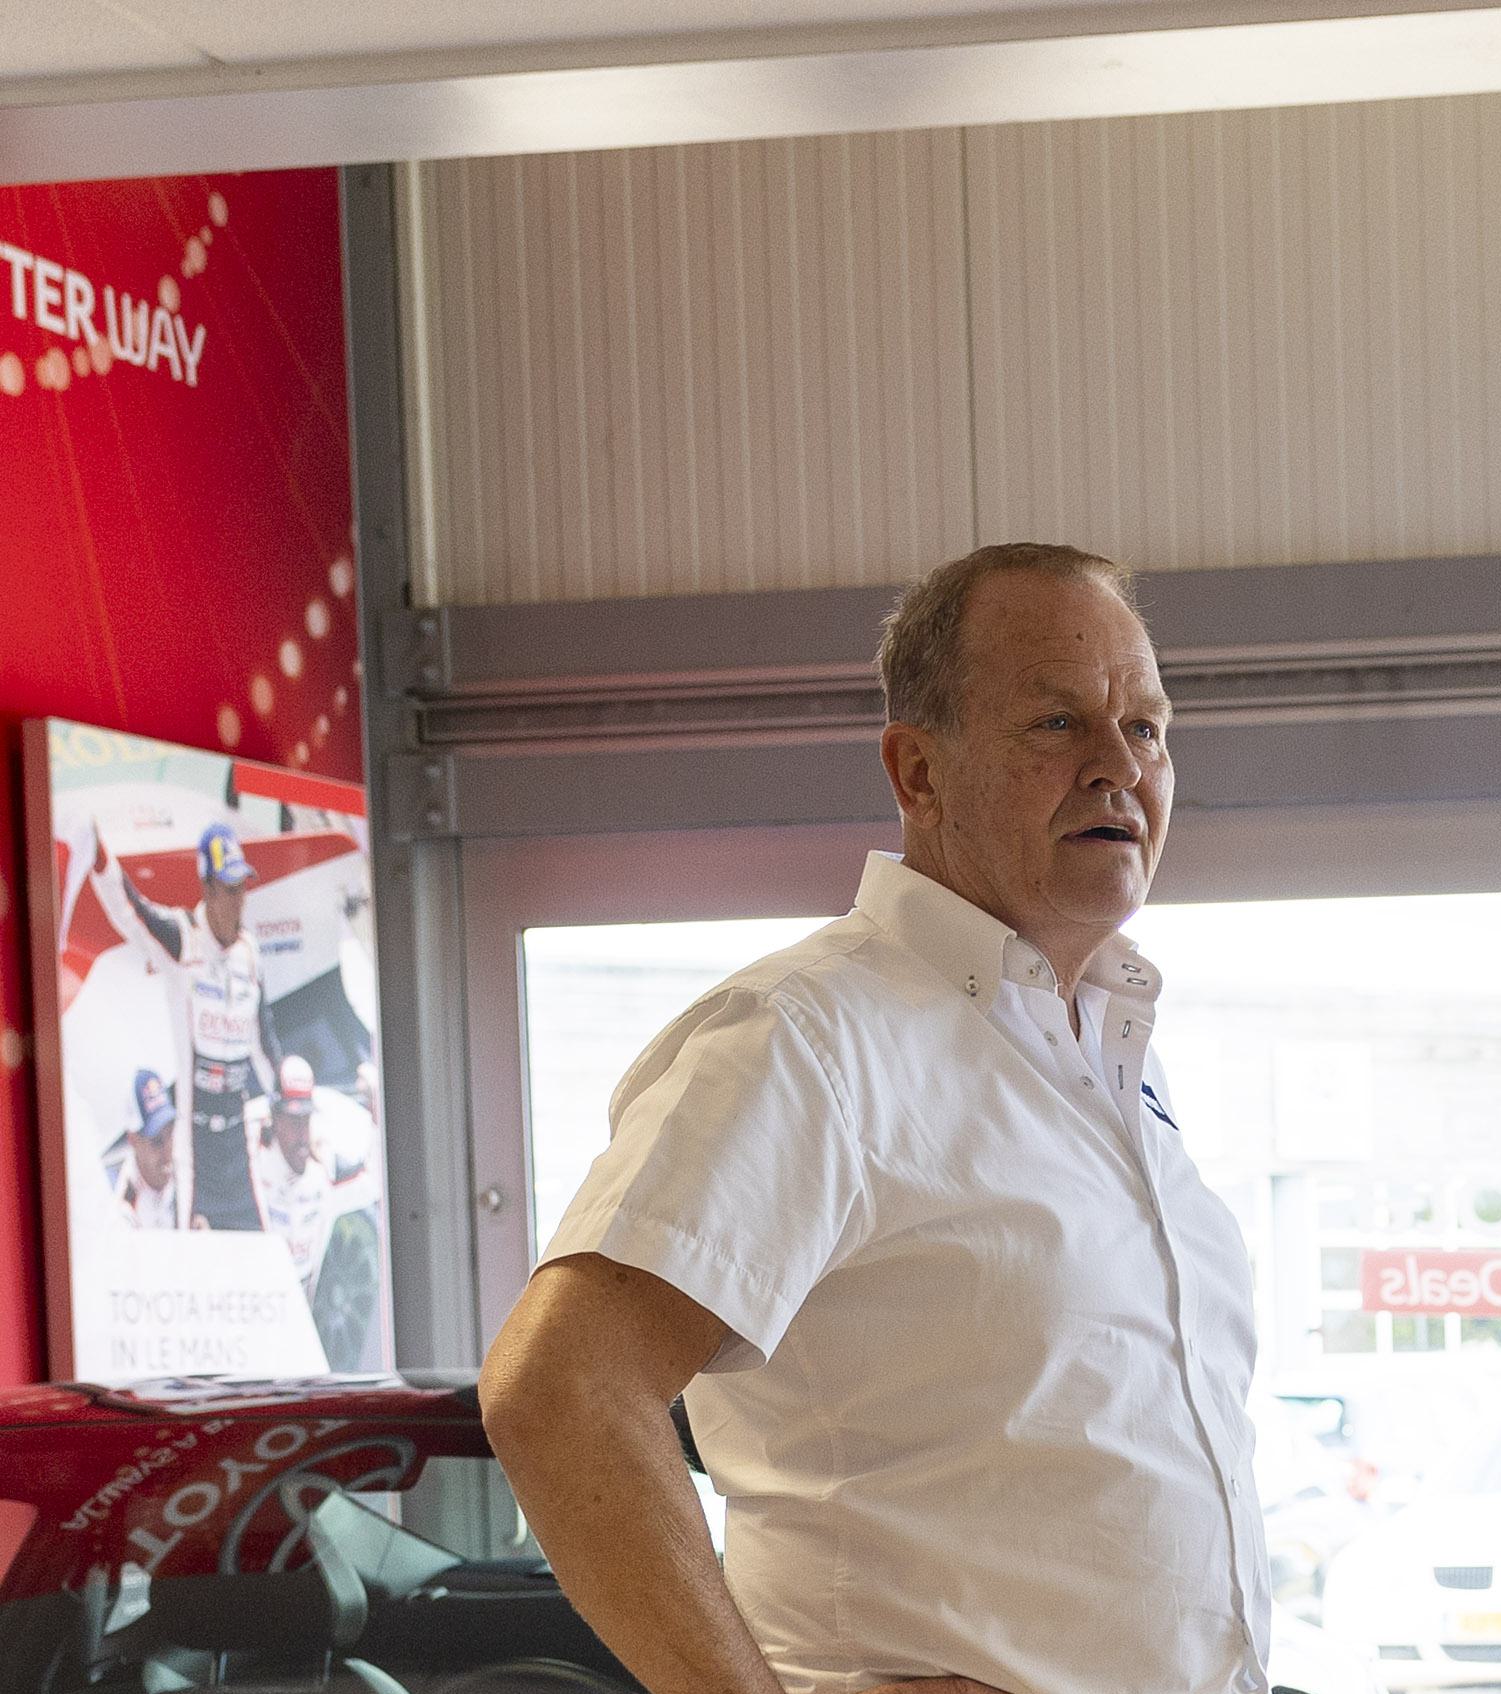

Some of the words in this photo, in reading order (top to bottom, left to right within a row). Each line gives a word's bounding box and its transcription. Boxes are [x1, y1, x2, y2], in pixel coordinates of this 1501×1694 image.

[104, 285, 207, 388] WAY
[108, 1289, 203, 1326] TOYOTA
[110, 1335, 138, 1371] IN
[144, 1335, 173, 1371] LE
[178, 1334, 250, 1371] MANS
